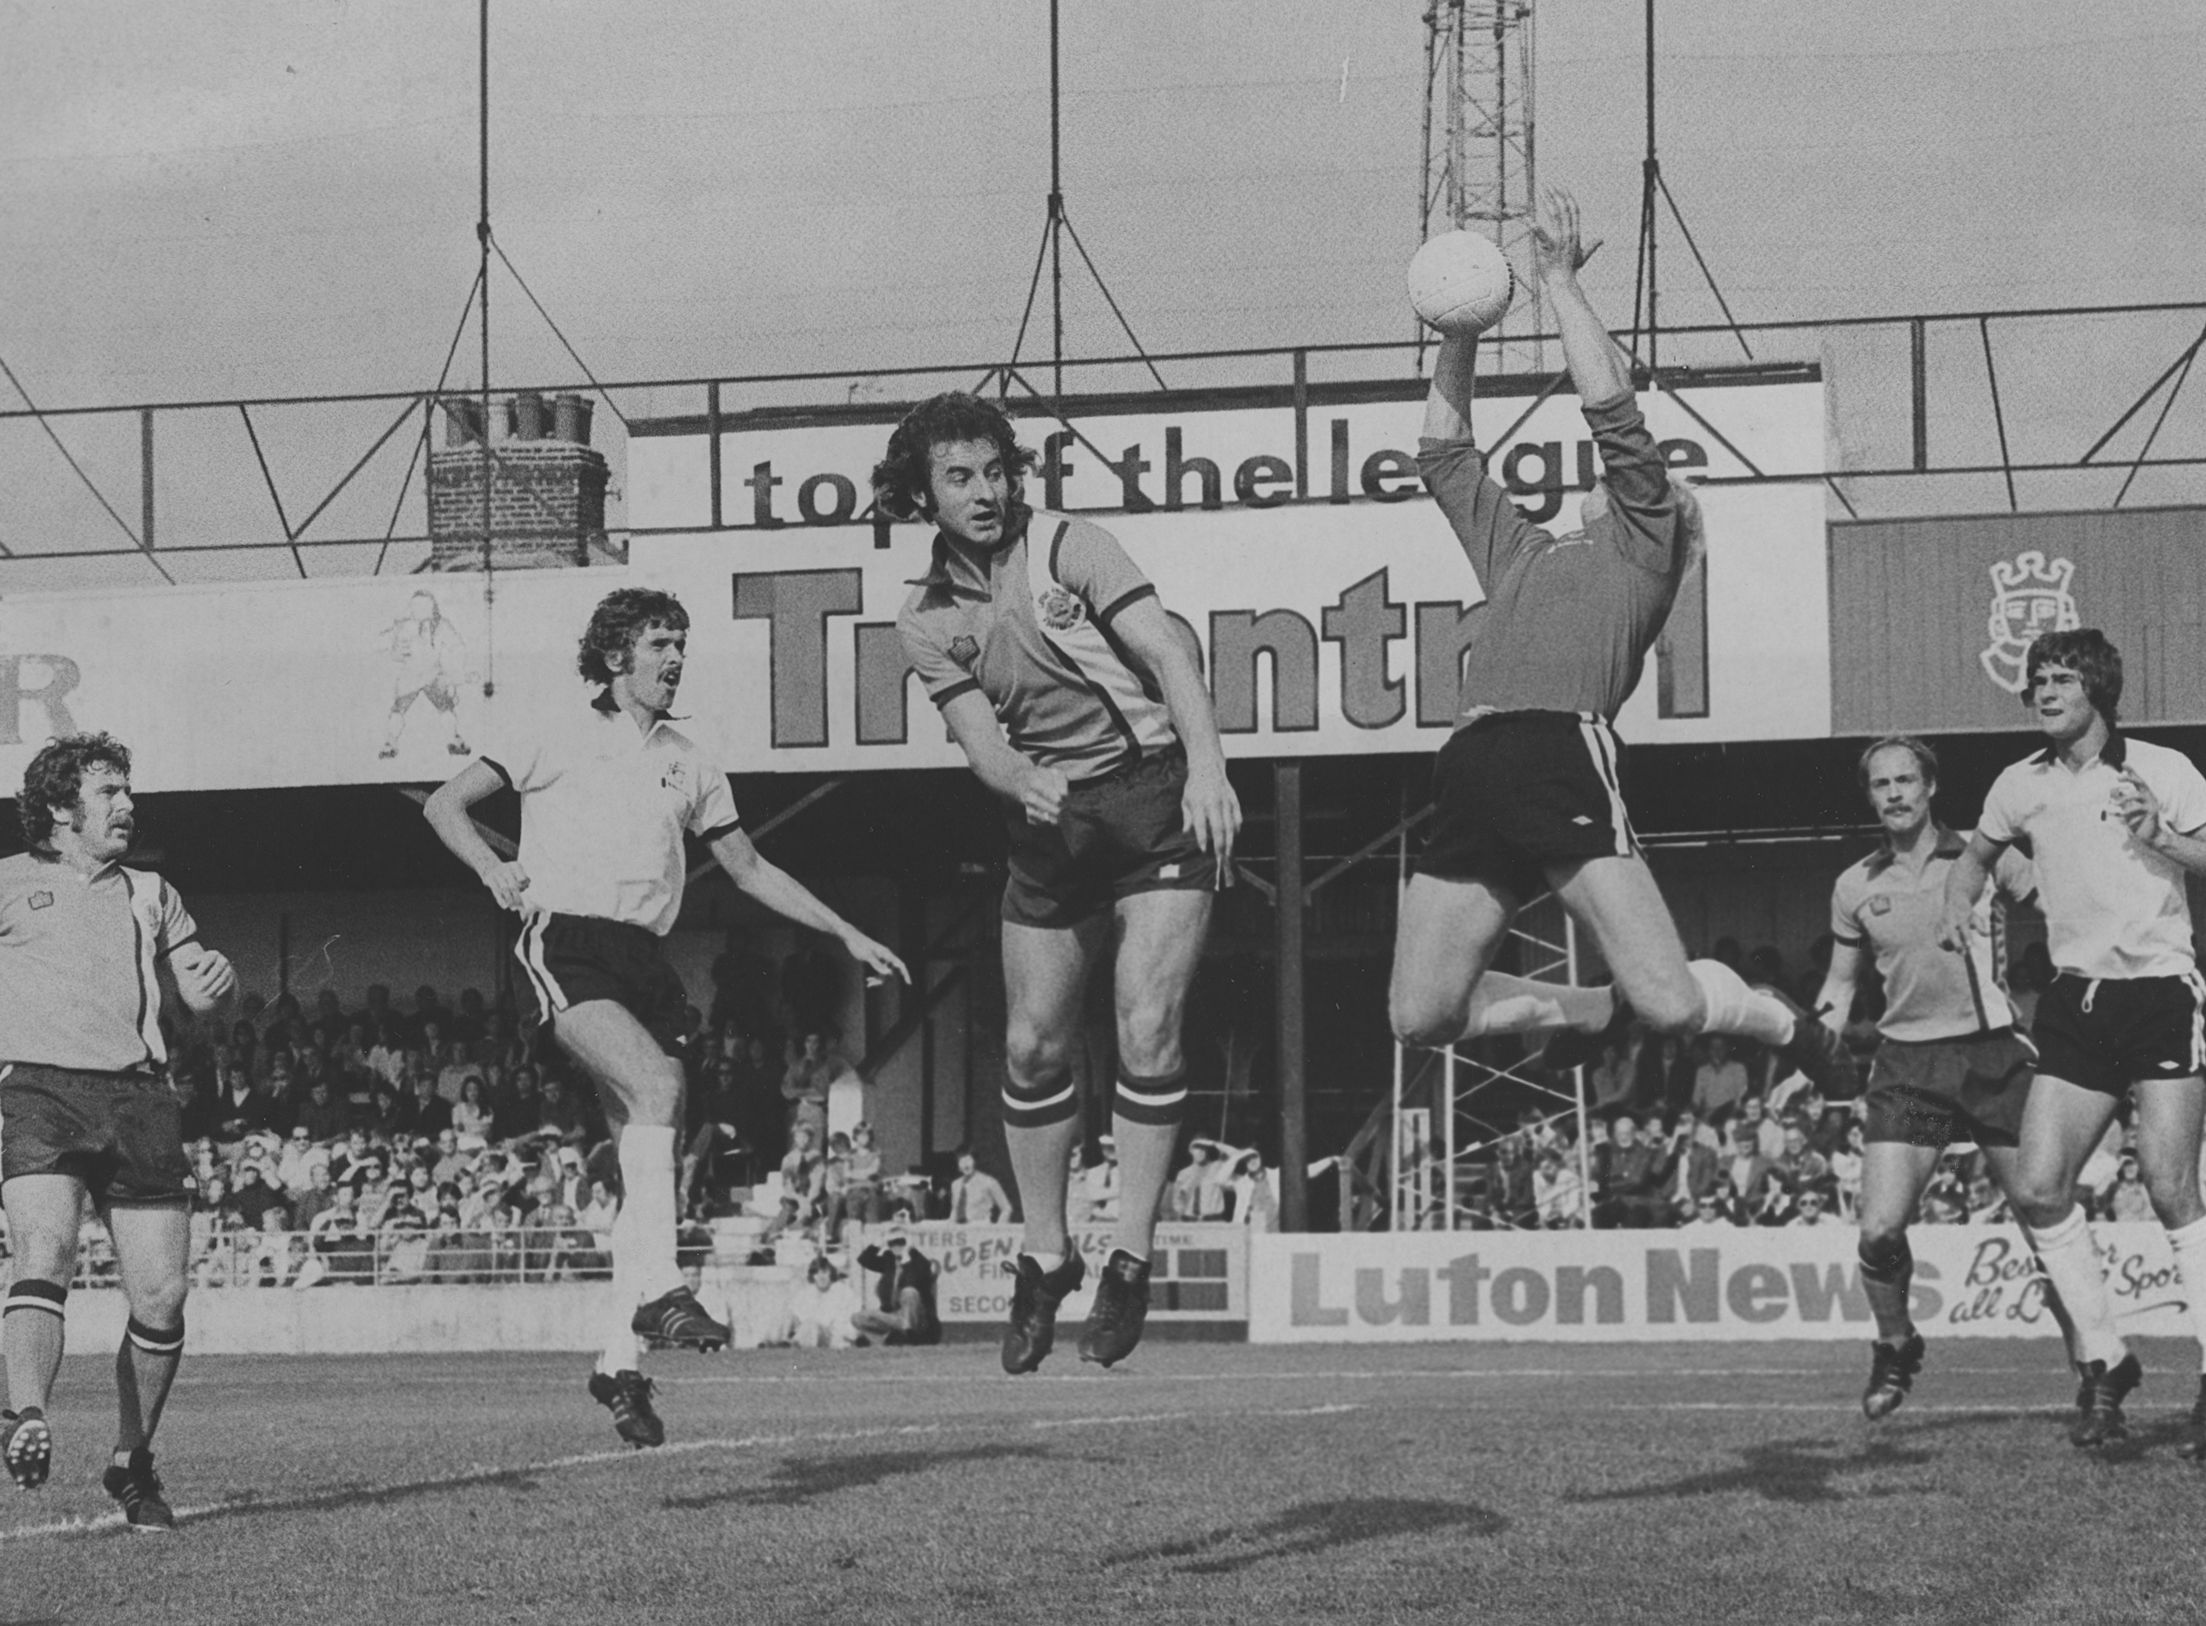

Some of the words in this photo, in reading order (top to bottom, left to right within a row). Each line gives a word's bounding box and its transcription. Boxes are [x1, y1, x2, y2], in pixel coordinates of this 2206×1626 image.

[1112, 426, 1293, 513] the
[917, 1231, 968, 1248] TERS
[928, 1236, 1014, 1276] OLDEN
[1964, 1236, 2037, 1288] Bes
[949, 1295, 1014, 1314] SECO
[1290, 1252, 1626, 1327] Luton
[1644, 1247, 1944, 1325] News
[1948, 1286, 2004, 1324] all
